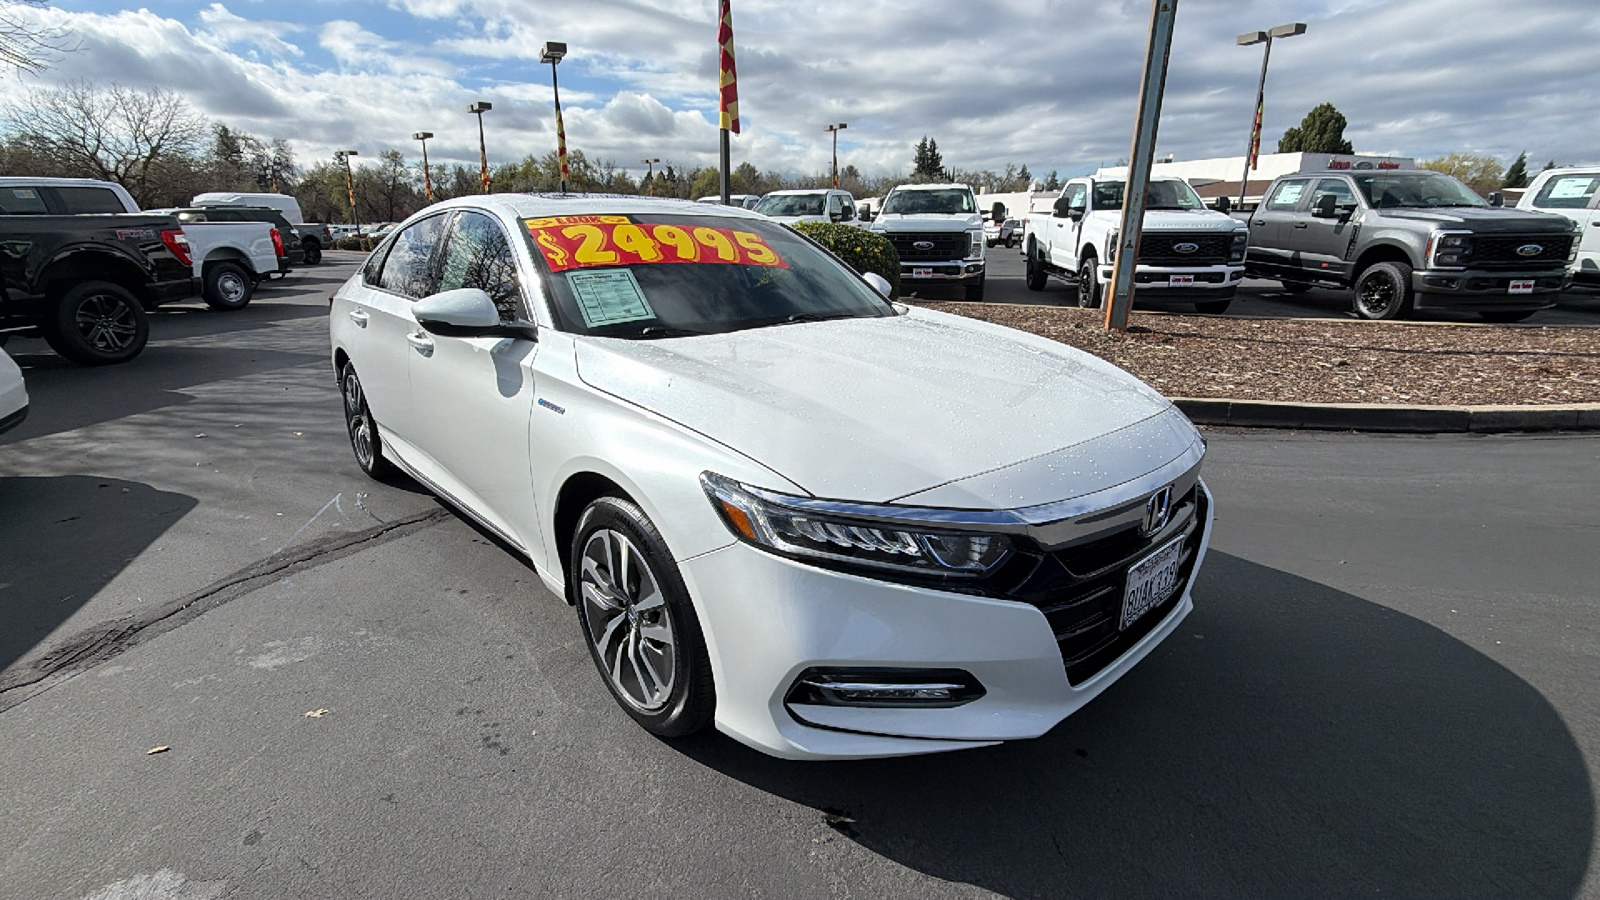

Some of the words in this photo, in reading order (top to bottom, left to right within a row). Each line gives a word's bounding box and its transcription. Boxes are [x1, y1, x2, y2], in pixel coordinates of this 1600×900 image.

[555, 216, 601, 224] LOOK
[537, 225, 780, 266] $24995
[614, 512, 653, 556] OMNIMAX
